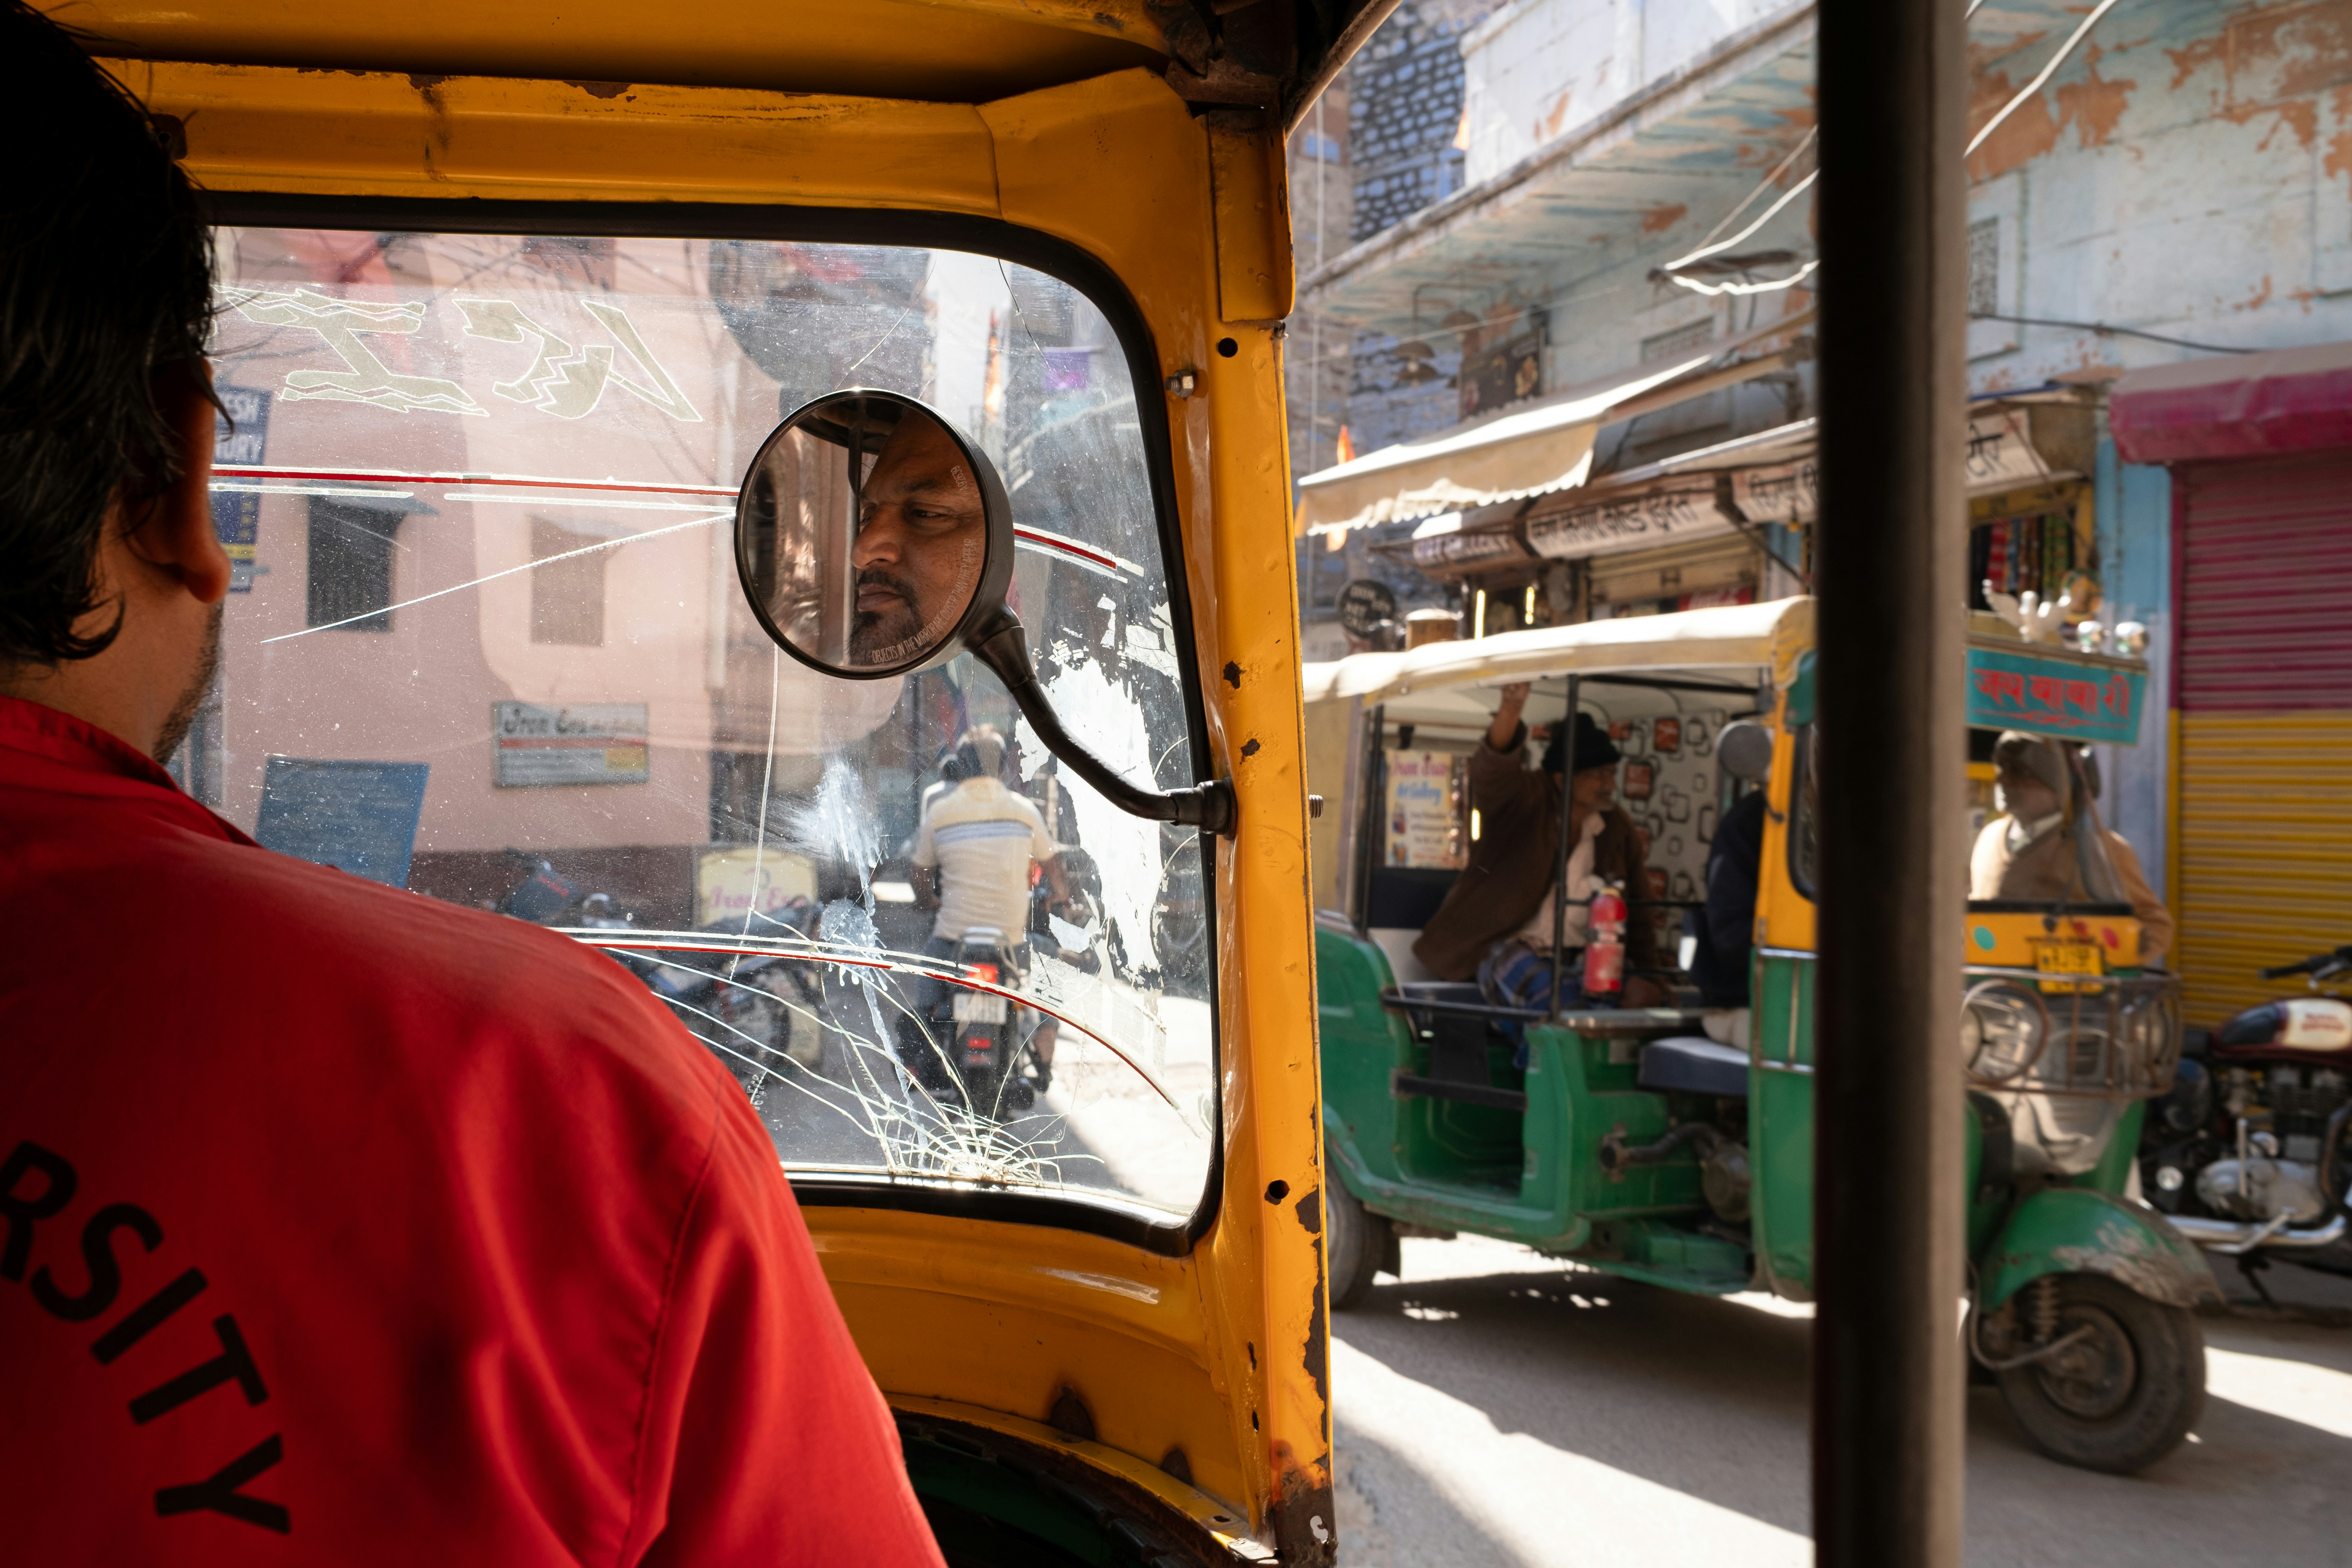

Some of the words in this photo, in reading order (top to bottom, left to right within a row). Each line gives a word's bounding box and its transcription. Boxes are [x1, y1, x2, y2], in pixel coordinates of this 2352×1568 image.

[951, 466, 969, 491] A92639
[962, 538, 977, 564] APPEAR
[957, 563, 972, 580] THEY
[951, 581, 969, 597] THAN
[940, 595, 961, 620] CLOSER
[932, 614, 948, 631] ARE
[914, 622, 940, 648] MIRROR
[897, 643, 905, 657] IN
[903, 636, 918, 653] THE
[872, 646, 898, 663] OBJECTS
[0, 1139, 291, 1536] RSITY
